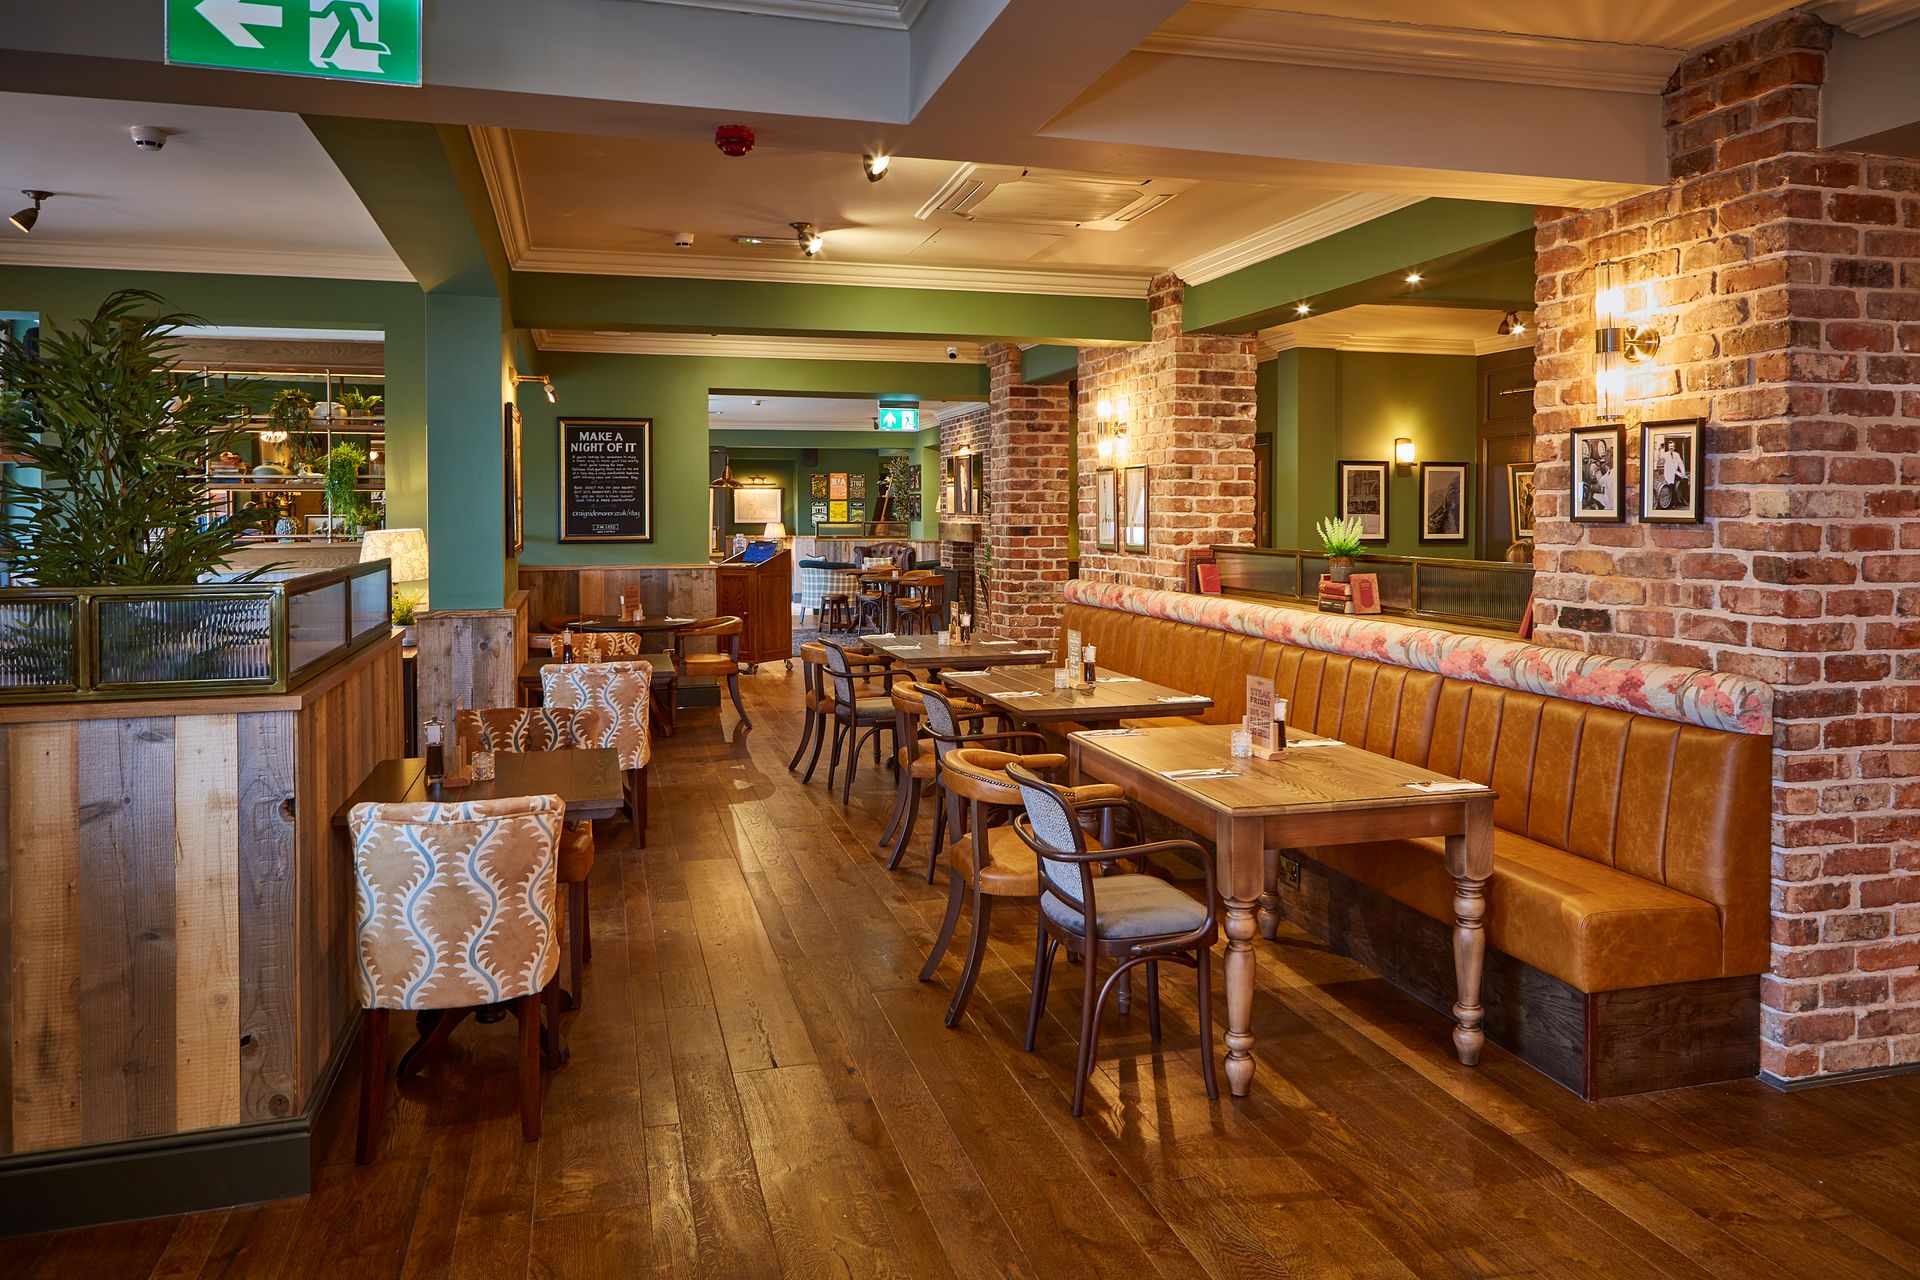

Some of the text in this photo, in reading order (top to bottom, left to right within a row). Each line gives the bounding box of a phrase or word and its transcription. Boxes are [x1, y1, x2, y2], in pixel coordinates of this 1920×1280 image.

[579, 432, 624, 442] MAKE A
[570, 442, 637, 452] NIGHT OF IT
[1250, 688, 1271, 700] STEAK
[1250, 696, 1271, 707] FRIDAY
[1261, 710, 1271, 719] OFF
